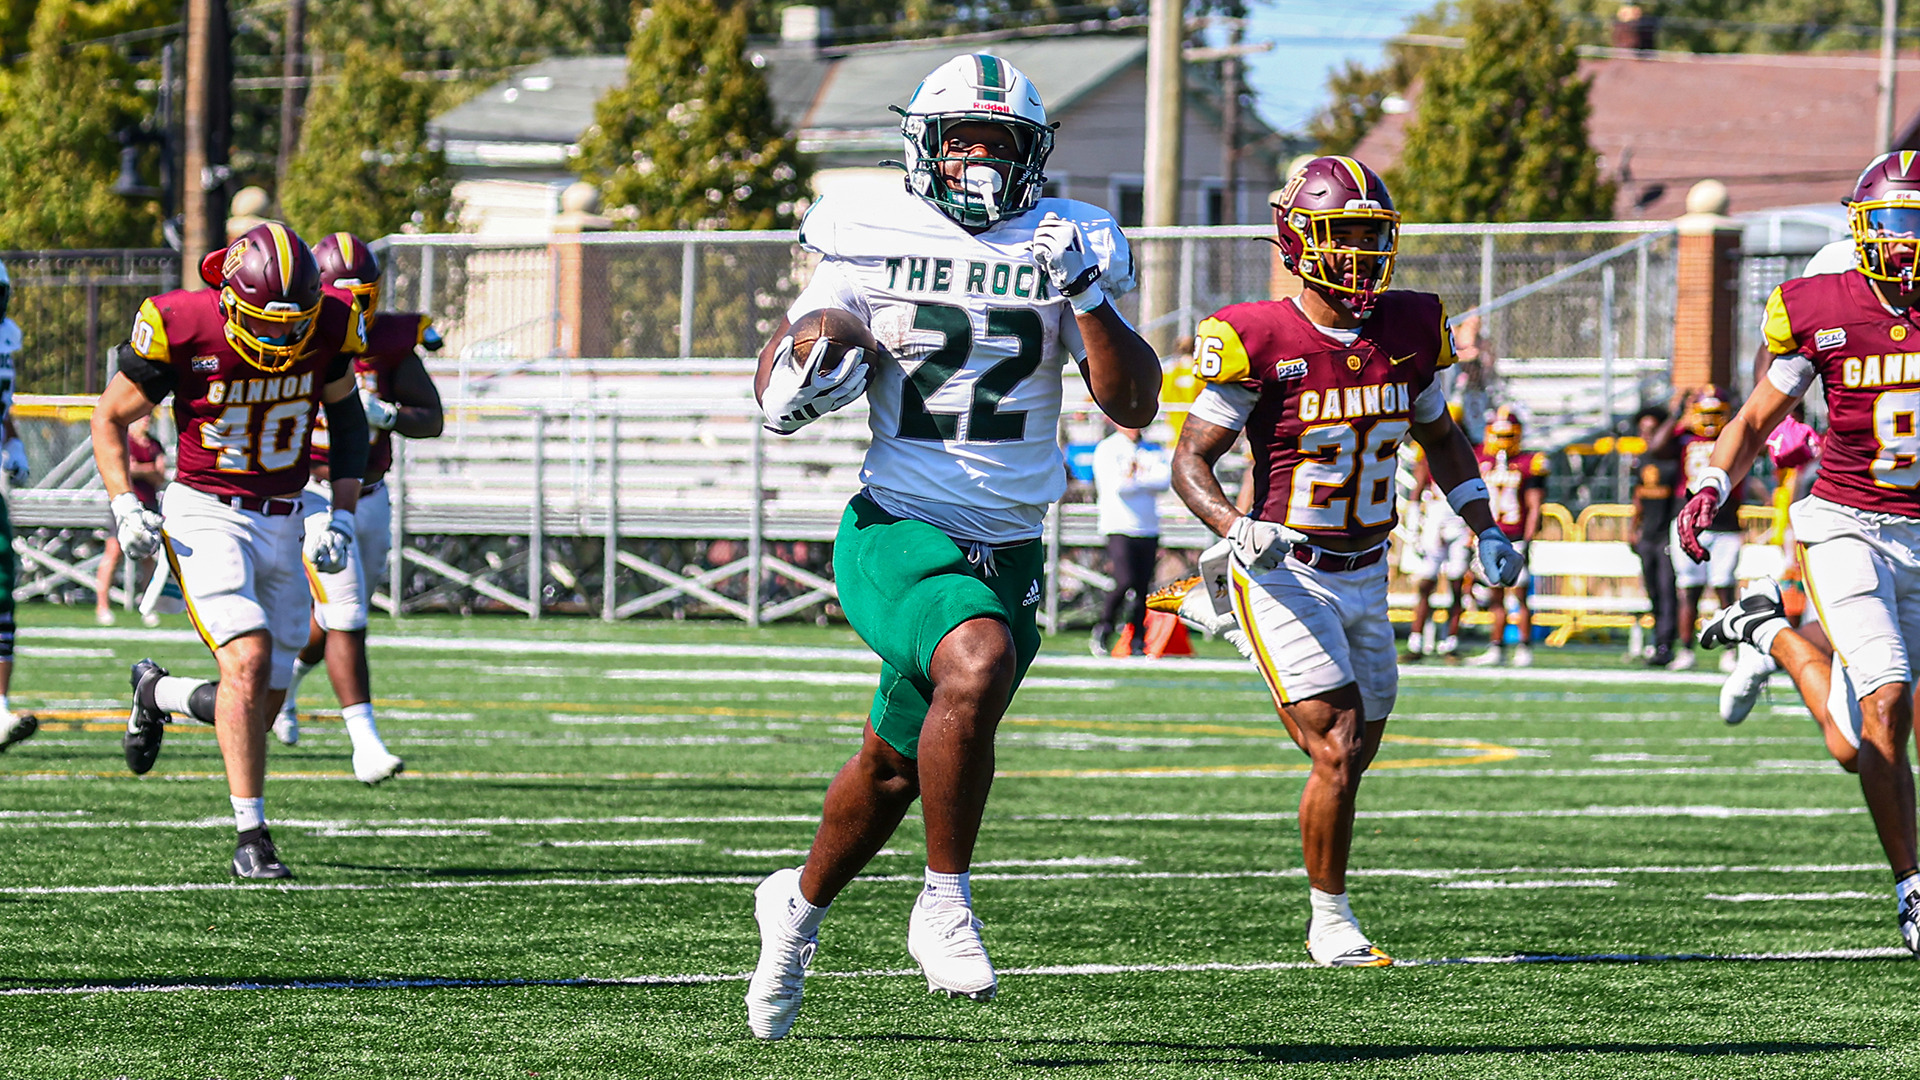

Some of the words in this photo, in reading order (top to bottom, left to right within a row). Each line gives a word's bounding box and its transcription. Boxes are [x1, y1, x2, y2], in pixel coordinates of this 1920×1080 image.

[973, 102, 1010, 113] Riddell
[885, 257, 954, 293] THE
[965, 259, 1049, 301] ROCK
[1817, 334, 1845, 345] PSAC
[206, 370, 313, 405] GANNON
[895, 302, 1044, 442] 22
[1278, 362, 1307, 376] PSAC
[1842, 352, 1920, 389] GANN
[1297, 381, 1411, 422] GANNON
[200, 399, 312, 473] 40
[1869, 388, 1920, 490] 8
[1283, 418, 1414, 530] 26
[1022, 594, 1041, 607] adidas
